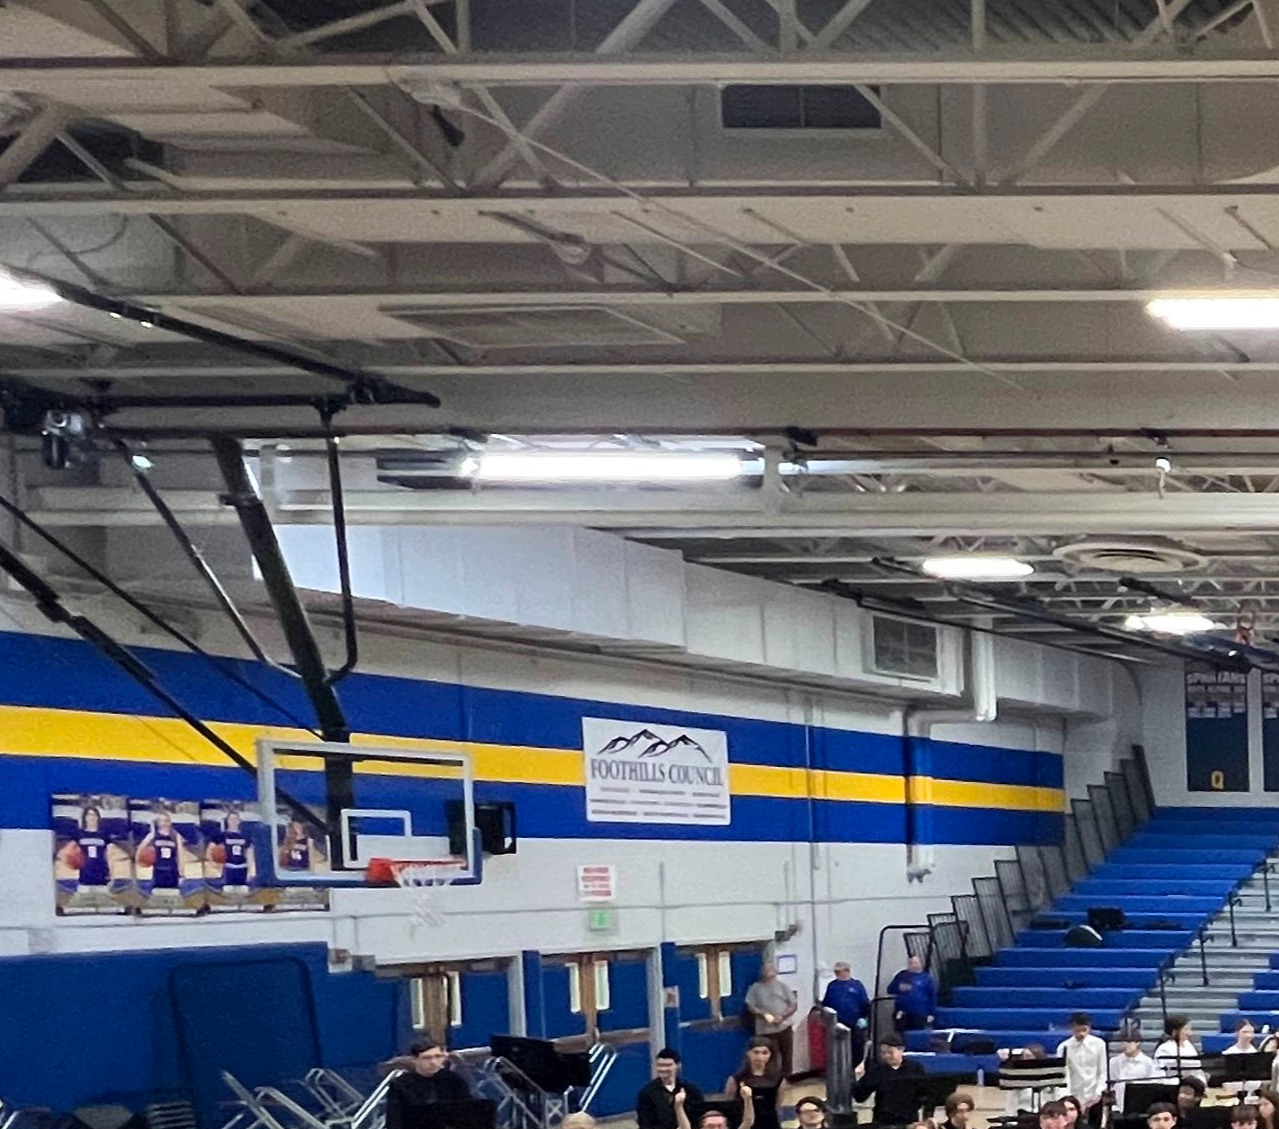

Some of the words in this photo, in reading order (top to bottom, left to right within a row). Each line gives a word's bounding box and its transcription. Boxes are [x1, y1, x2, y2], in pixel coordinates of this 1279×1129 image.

[590, 758, 665, 782] FOOTHILLS
[668, 763, 723, 786] COUNCIL
[1211, 770, 1225, 790] Q
